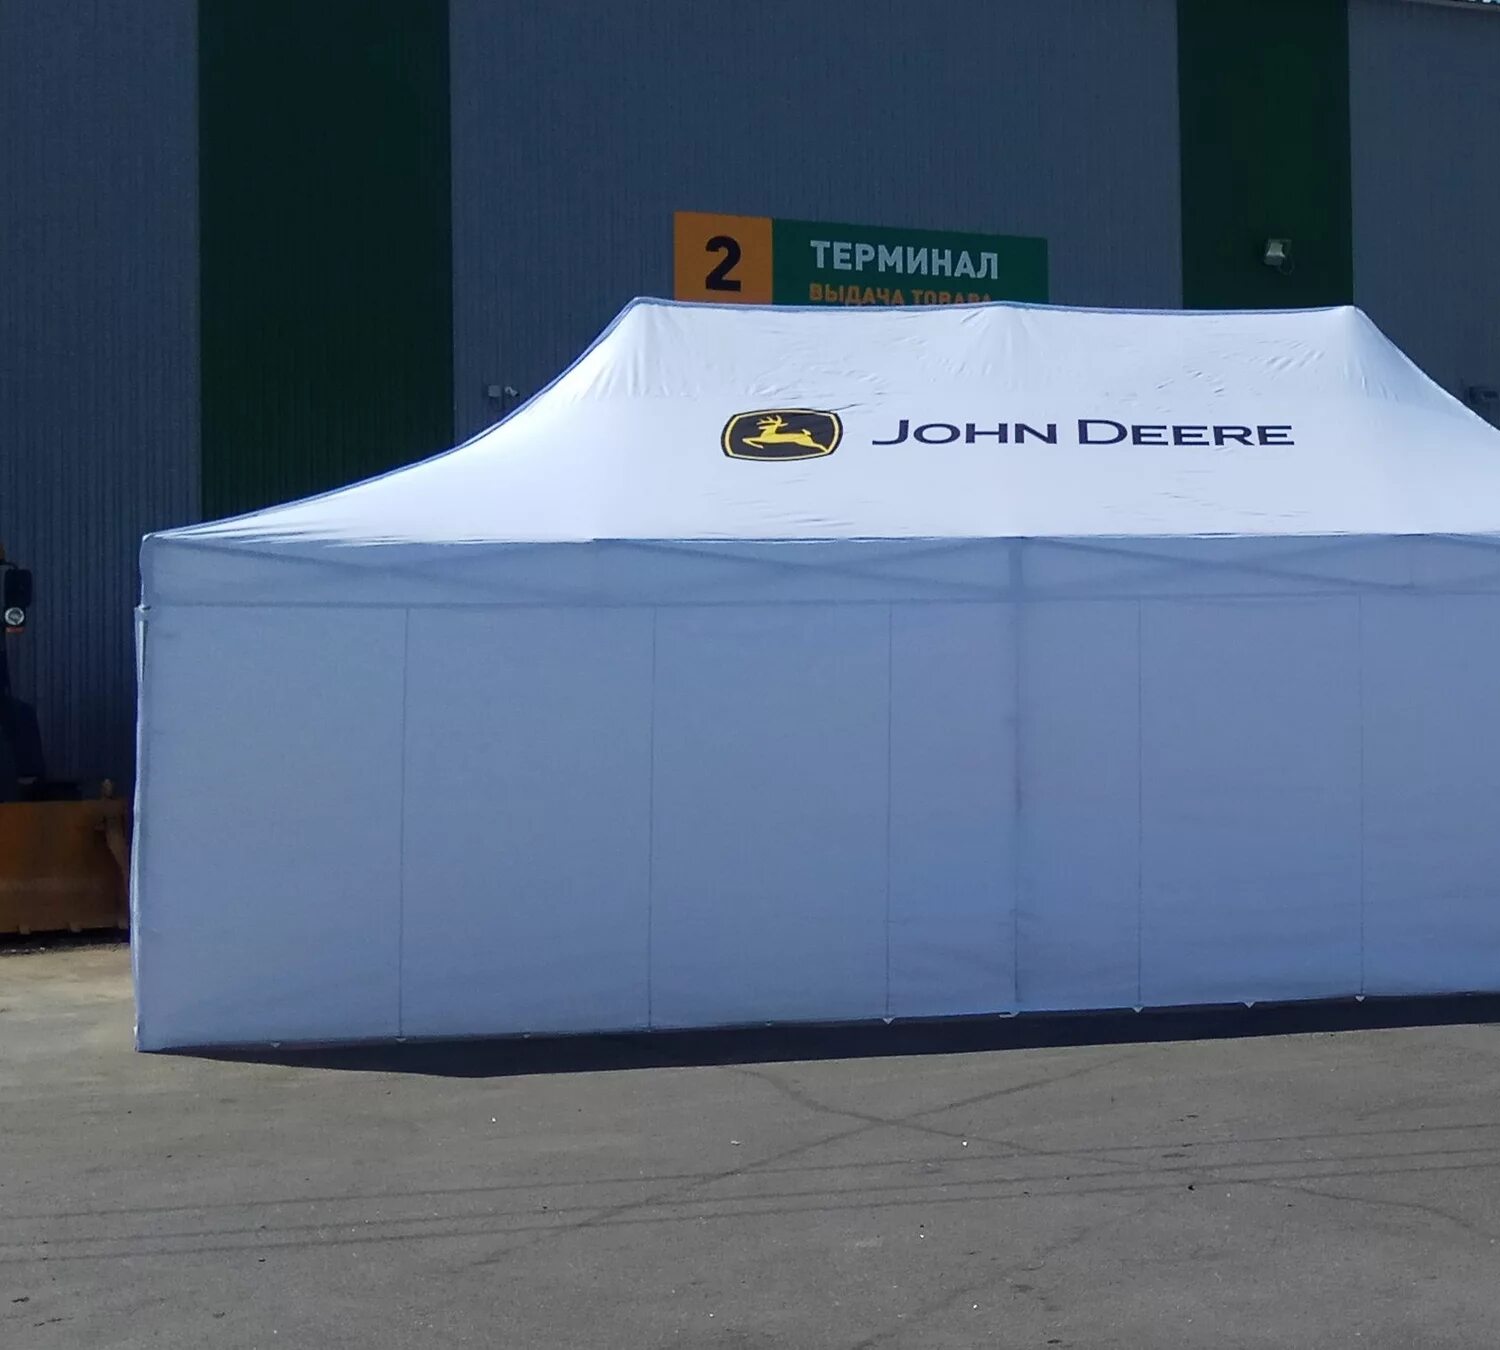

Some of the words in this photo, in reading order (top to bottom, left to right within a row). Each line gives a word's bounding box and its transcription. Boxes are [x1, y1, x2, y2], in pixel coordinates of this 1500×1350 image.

[705, 235, 742, 292] 2
[810, 239, 999, 280] ТЕРМИНАЛ
[809, 282, 905, 306] ВЫДАЧА
[872, 419, 1057, 446] JOHN
[1078, 419, 1295, 446] DEERE
